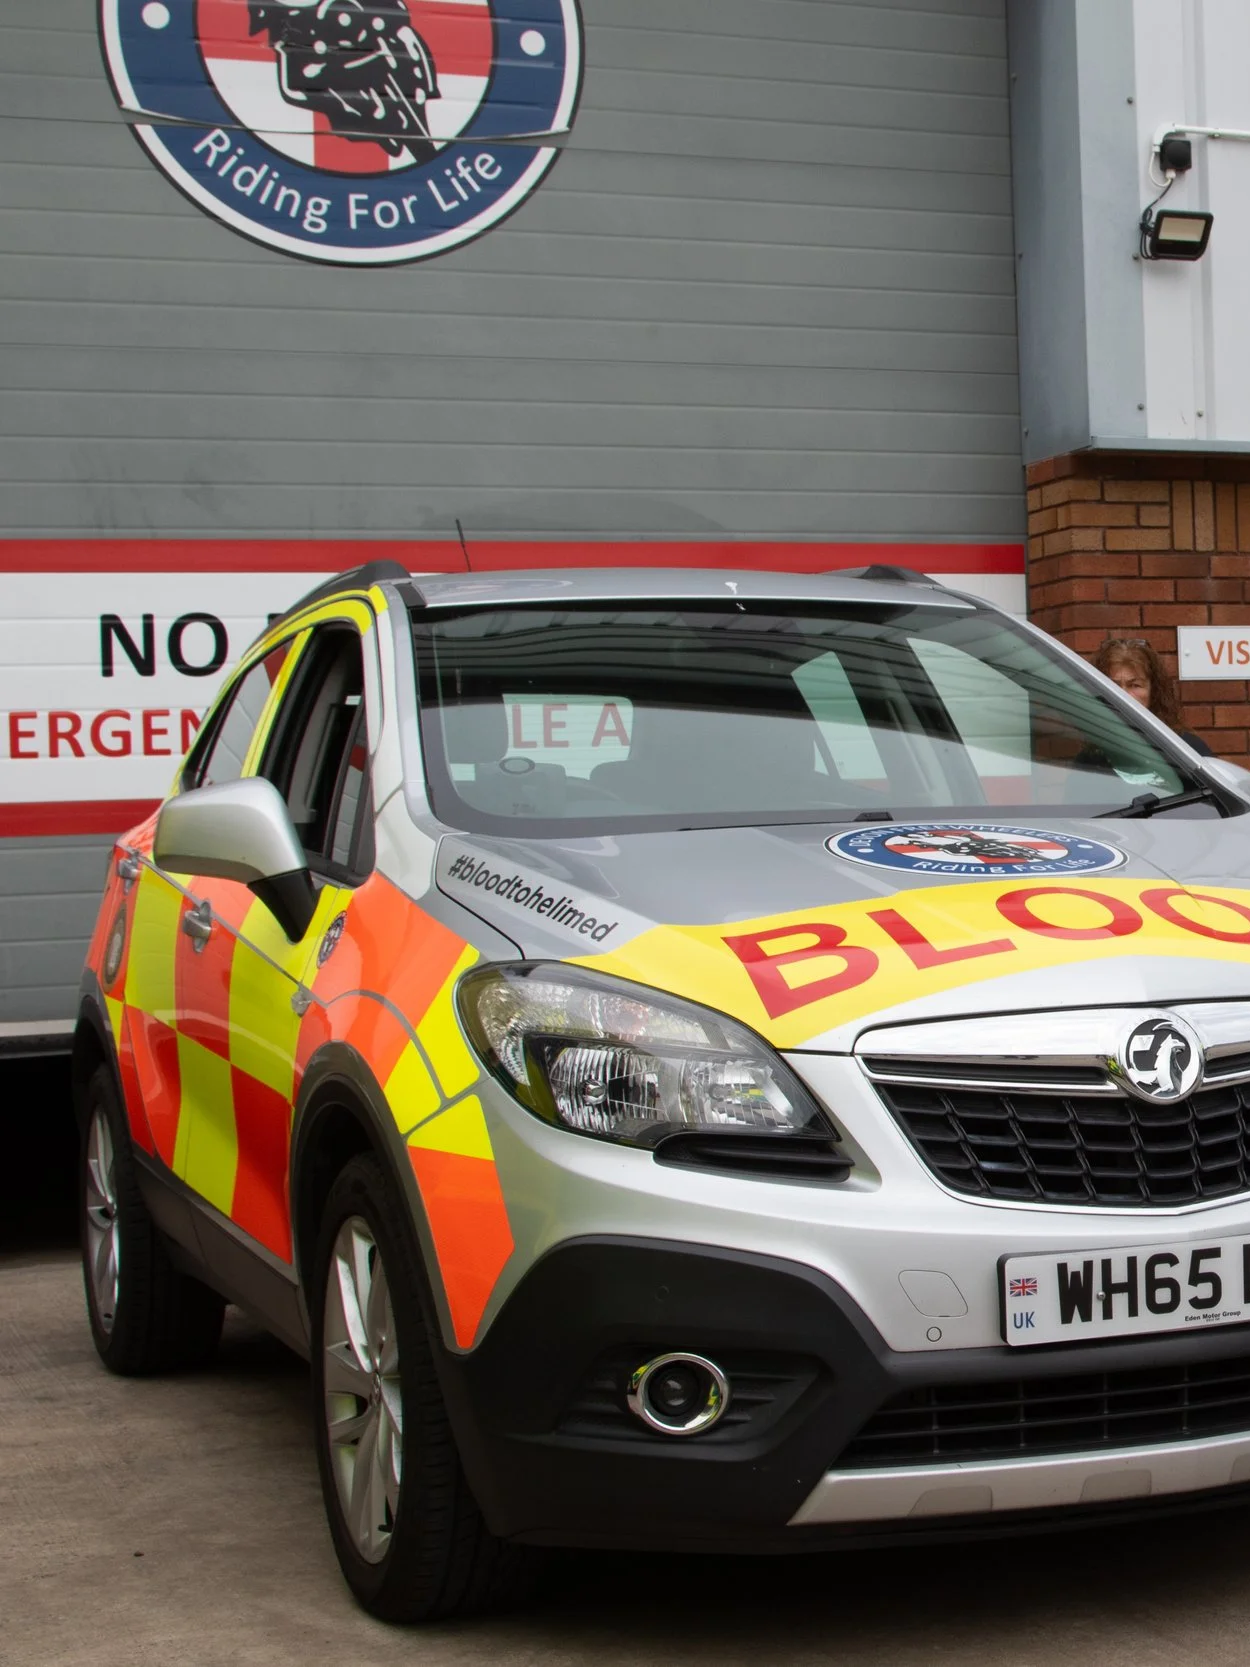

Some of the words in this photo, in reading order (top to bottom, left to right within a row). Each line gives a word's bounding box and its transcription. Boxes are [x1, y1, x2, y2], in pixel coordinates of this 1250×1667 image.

[193, 128, 332, 233] Riding
[347, 193, 418, 230] For
[427, 149, 503, 214] Life
[98, 612, 230, 678] NO
[447, 855, 619, 942] #bloodtohelimed
[912, 860, 1006, 874] Riding
[1013, 863, 1057, 872] For
[1056, 859, 1096, 869] Life
[1057, 1246, 1223, 1325] WH65
[1202, 1312, 1221, 1320] Motor
[1013, 1311, 1036, 1330] UK
